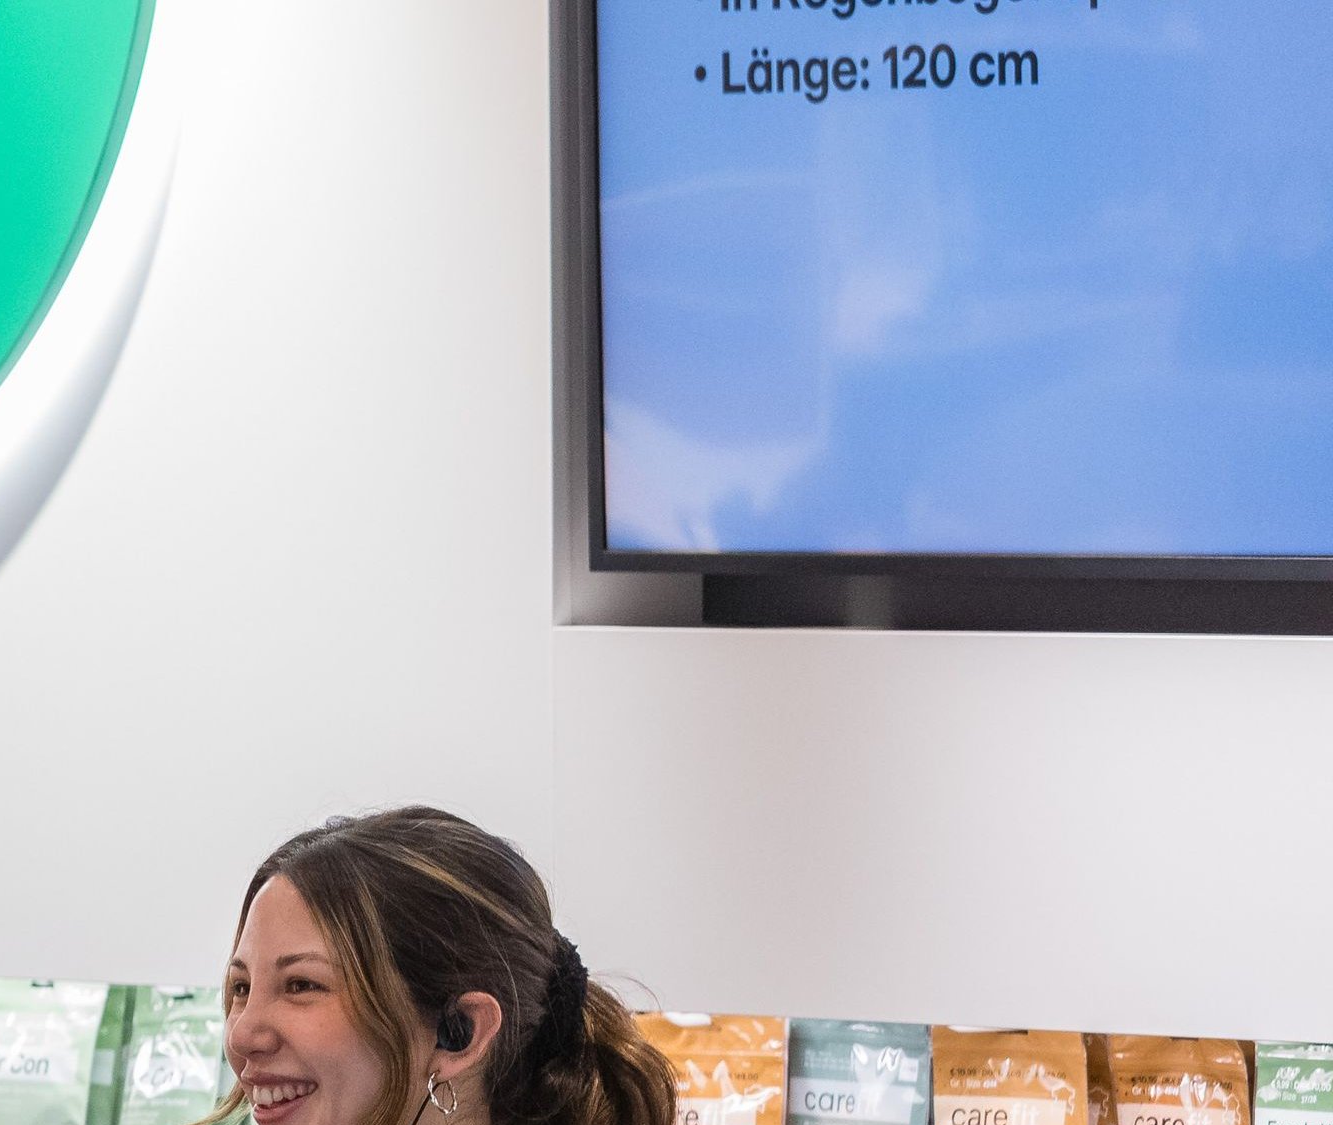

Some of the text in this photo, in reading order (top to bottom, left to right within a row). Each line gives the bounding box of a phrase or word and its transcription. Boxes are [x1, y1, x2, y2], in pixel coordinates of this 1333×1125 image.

[722, 44, 1040, 103] Länge: 120 cm
